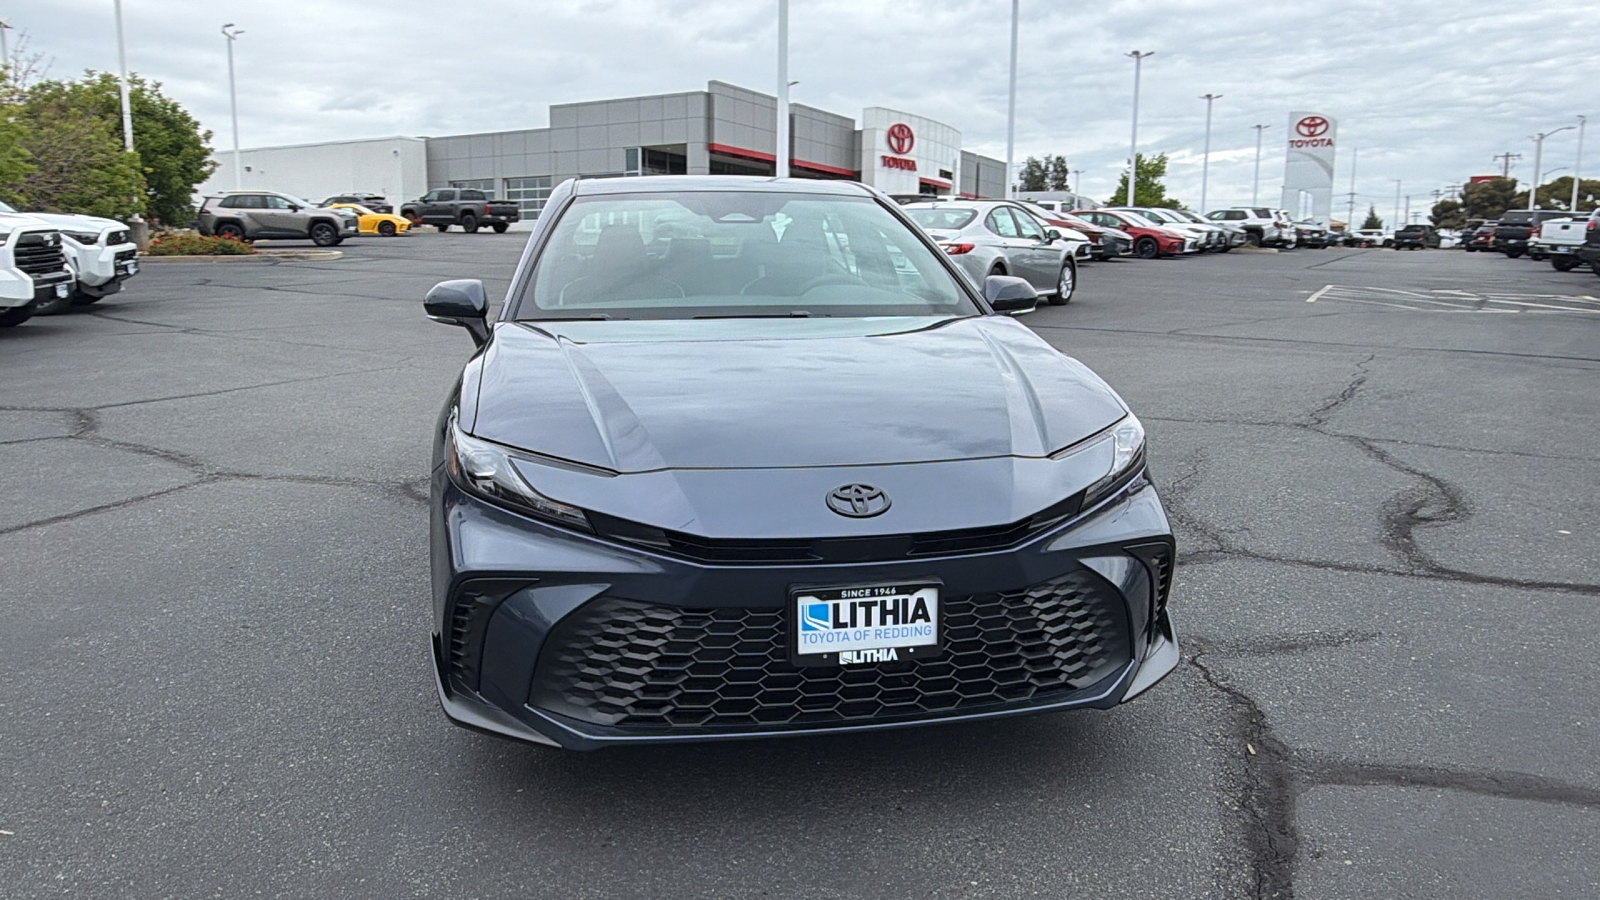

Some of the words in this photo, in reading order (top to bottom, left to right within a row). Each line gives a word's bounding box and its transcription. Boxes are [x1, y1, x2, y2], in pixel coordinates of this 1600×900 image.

[1289, 138, 1333, 148] TOYOTA
[881, 156, 917, 171] TOYOTA
[841, 589, 871, 598] SINCE
[874, 587, 897, 596] 1946
[832, 597, 931, 629] LITHIA
[802, 631, 850, 644] TOYOTA
[854, 629, 871, 641] OF
[874, 626, 932, 639] REDDING
[852, 648, 898, 663] LITHIA
